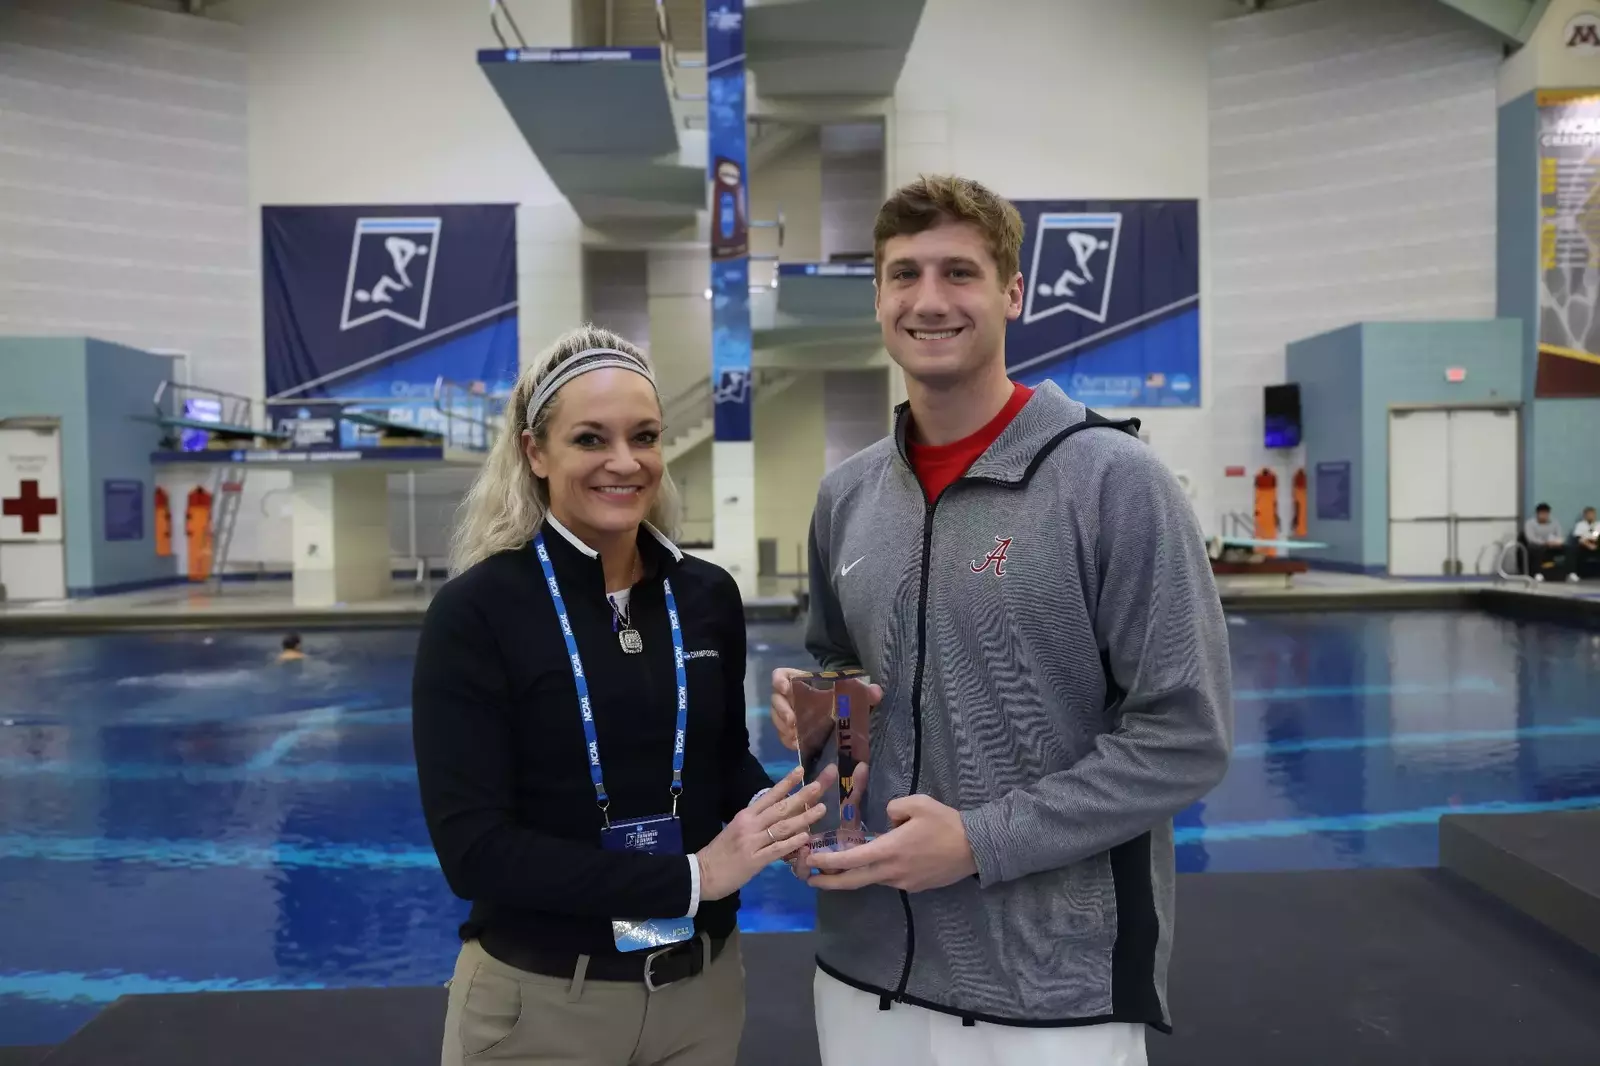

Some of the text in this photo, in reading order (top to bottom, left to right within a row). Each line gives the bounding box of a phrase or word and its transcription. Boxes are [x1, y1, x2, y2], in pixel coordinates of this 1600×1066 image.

[560, 612, 573, 636] NCAA
[668, 608, 680, 630] NCAA
[571, 652, 583, 677] NCAA
[674, 645, 685, 669] NCAA
[580, 695, 593, 722] NCAA
[678, 685, 686, 711] NCAA
[589, 740, 600, 766] NCAA
[675, 729, 684, 755] NCAA
